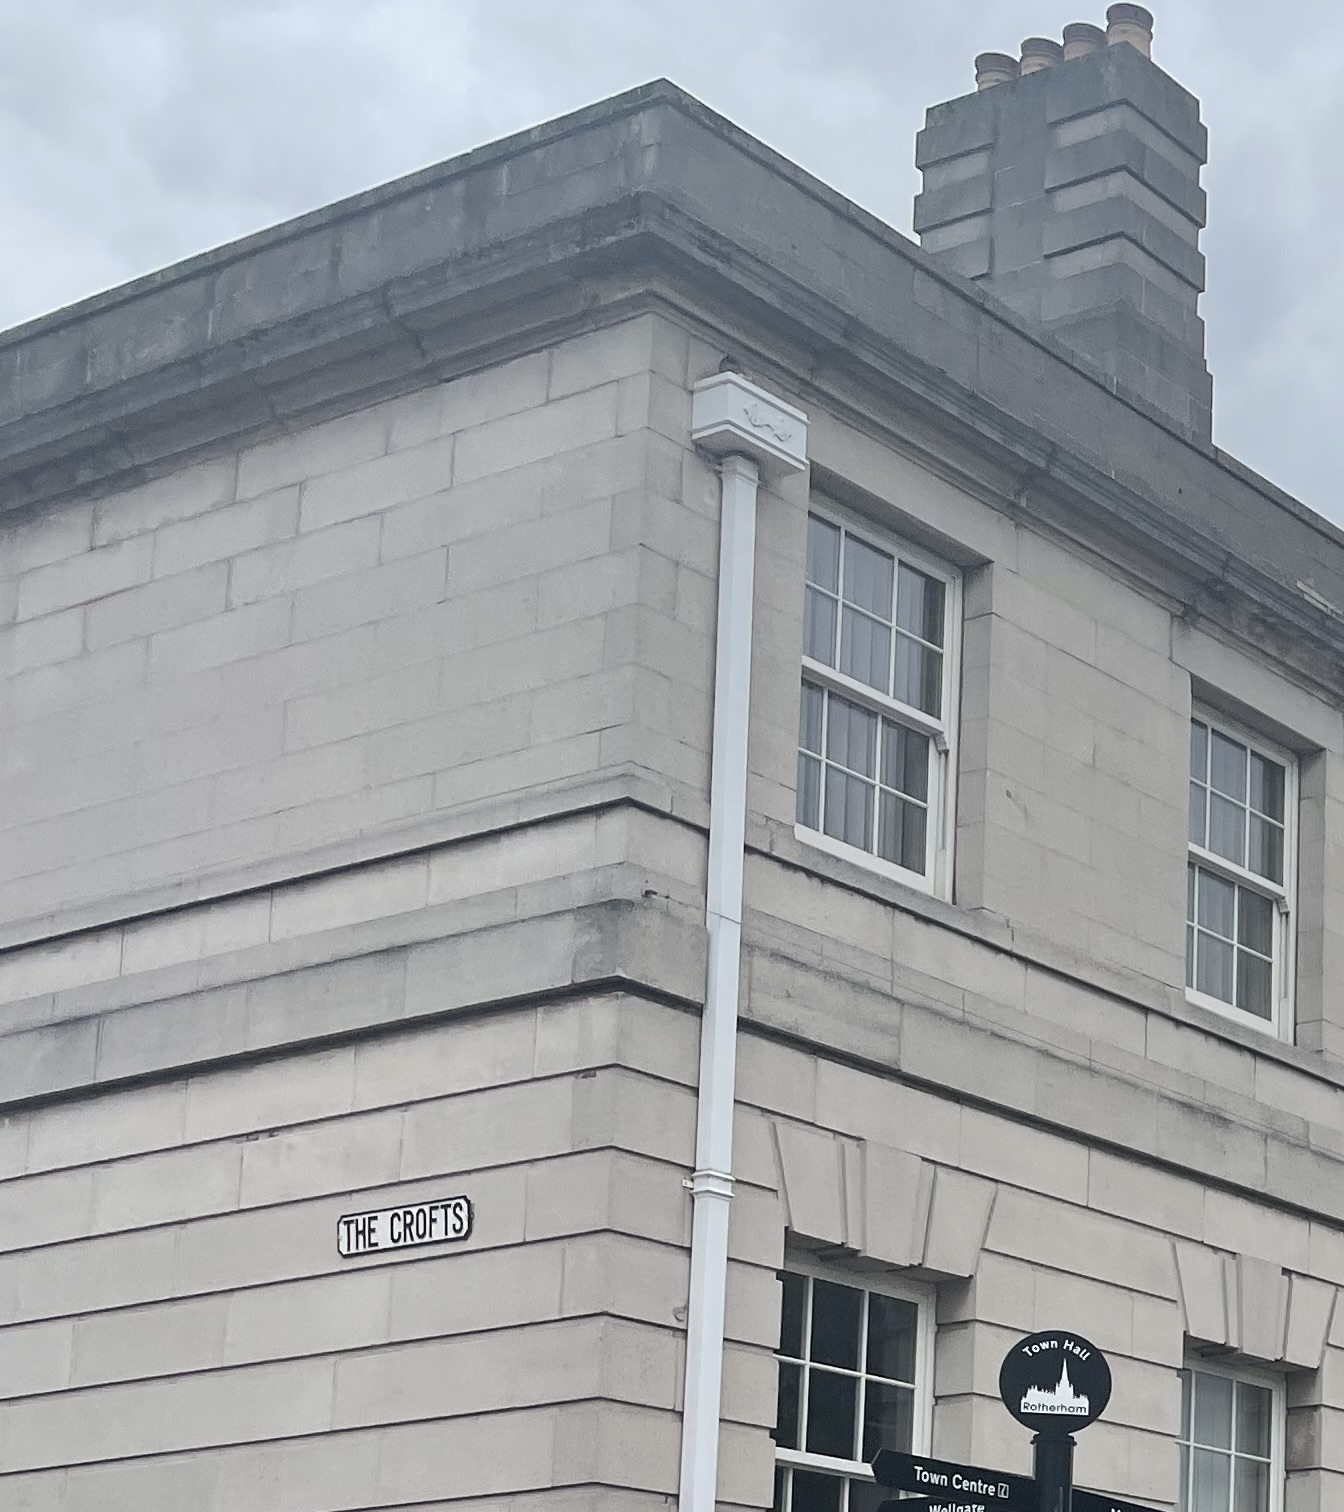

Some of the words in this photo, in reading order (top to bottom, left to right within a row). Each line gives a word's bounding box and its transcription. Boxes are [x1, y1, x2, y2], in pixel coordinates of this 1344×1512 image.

[343, 1215, 379, 1252] THE
[390, 1202, 464, 1244] CROFTS
[1022, 1340, 1058, 1357] Town
[1063, 1339, 1091, 1361] Hall
[1023, 1402, 1087, 1414] Rotherham
[914, 1465, 948, 1487] Town
[952, 1474, 996, 1496] Centre
